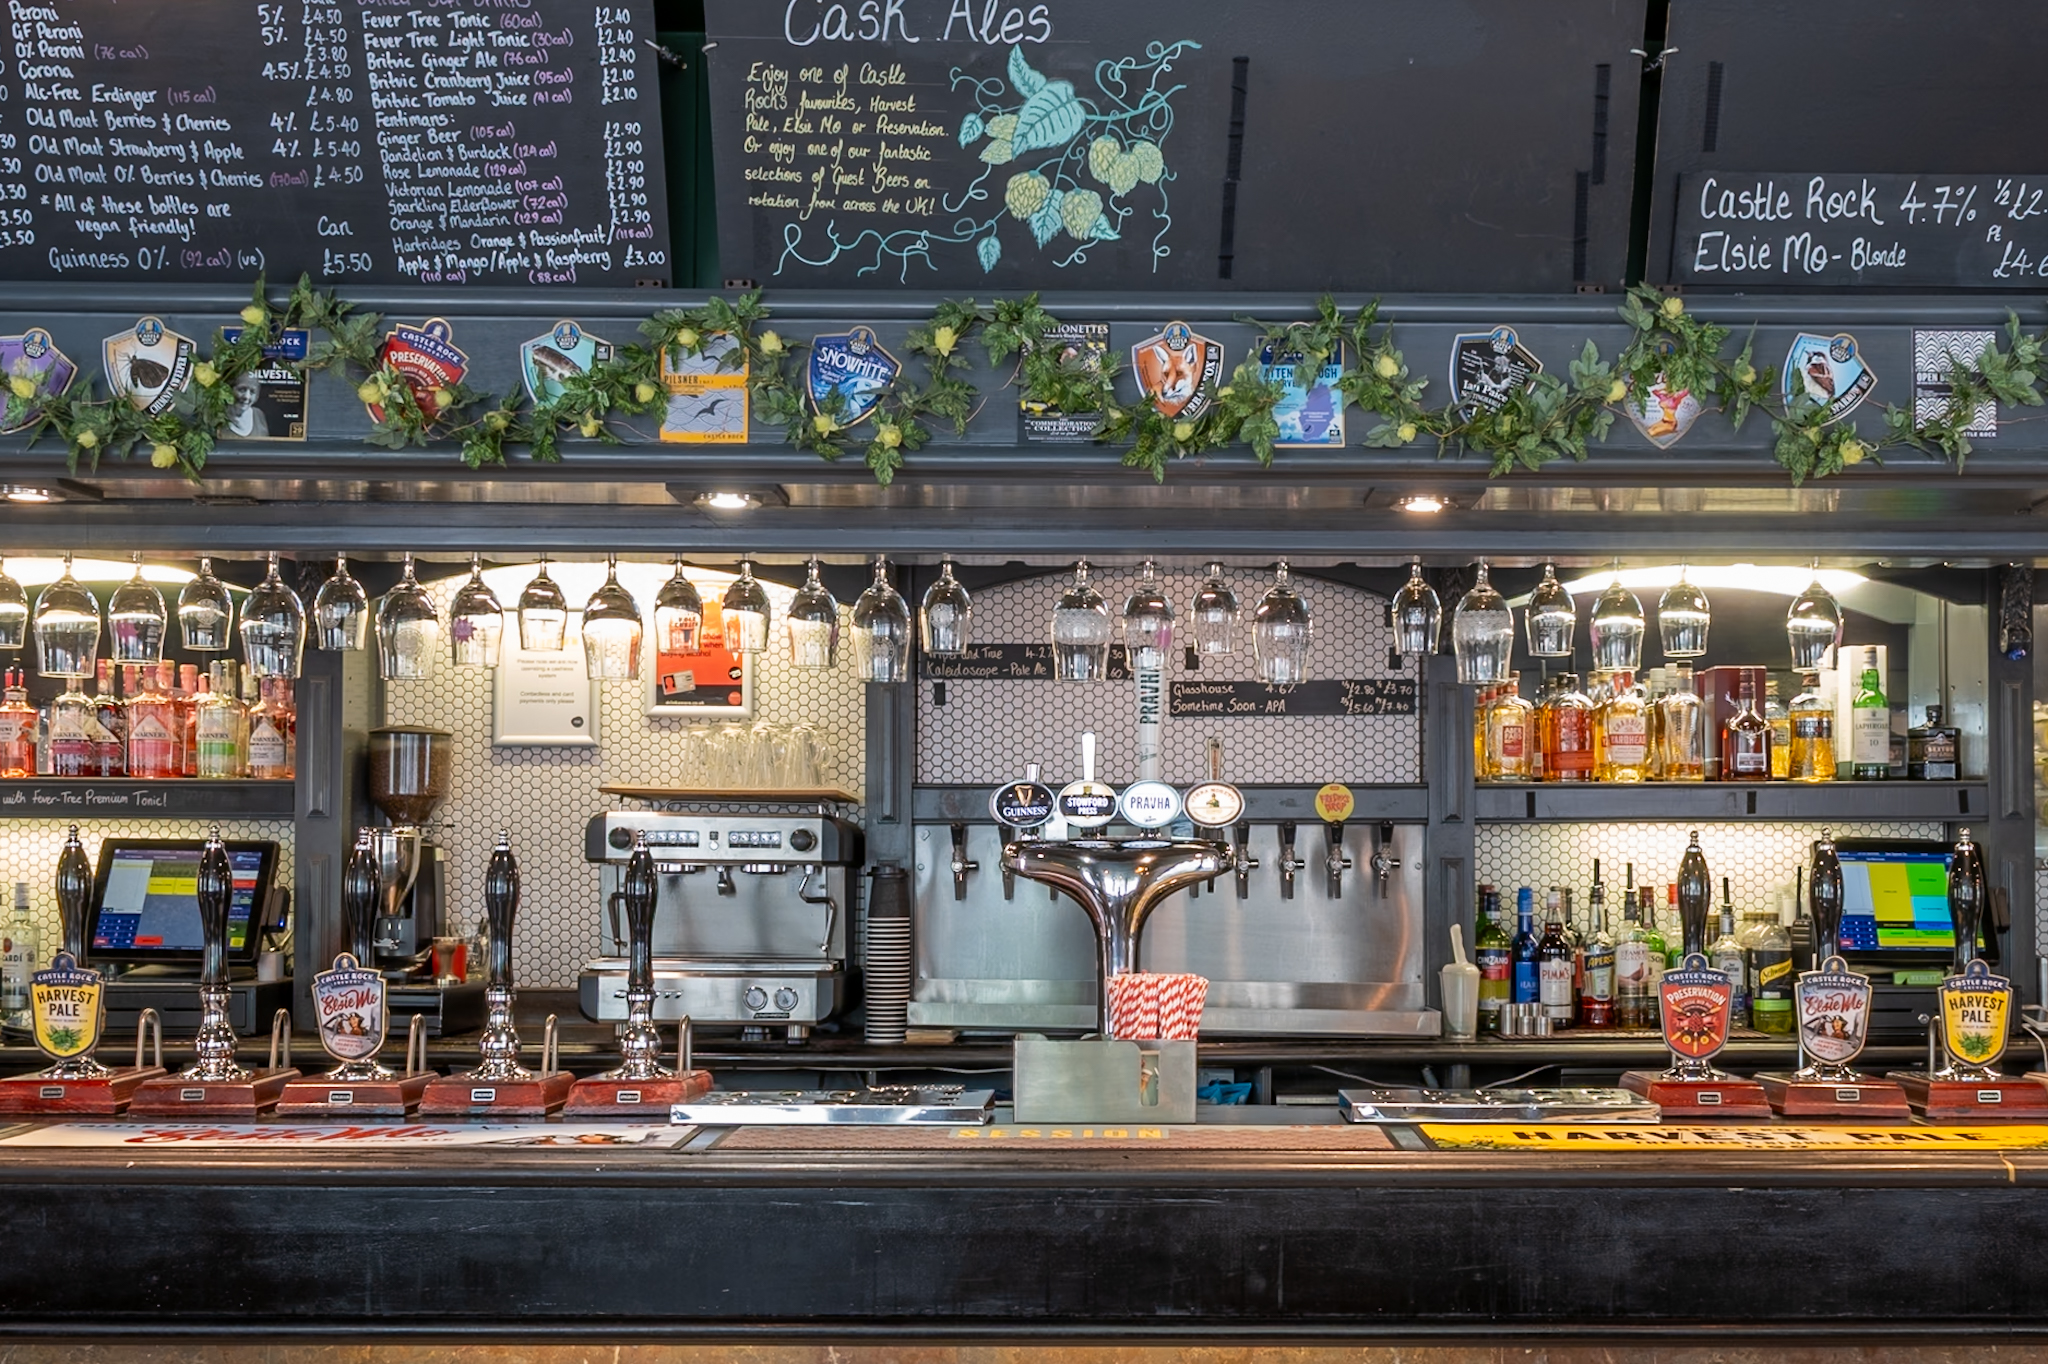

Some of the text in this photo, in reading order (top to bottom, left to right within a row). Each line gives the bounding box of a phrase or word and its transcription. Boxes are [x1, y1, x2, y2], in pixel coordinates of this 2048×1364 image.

[8, 1, 59, 21] Peroni
[257, 4, 342, 25] 5% £4.50
[361, 10, 491, 29] Fever Tree Tonic
[594, 6, 631, 28] £2.40
[784, 0, 1052, 46] Cask Ales
[15, 41, 85, 59] 0% Peroni
[18, 60, 74, 80] Corona
[366, 51, 498, 74] Britvic Ginger Ale
[368, 70, 530, 94] Britvic Cranberry Juice
[747, 61, 906, 98] Enjoy one of Castle
[25, 83, 157, 111] Alc-Free Erdinger
[795, 90, 861, 119] favourites,
[870, 94, 916, 113] Harvest
[26, 108, 231, 132] Old Mout Berries Cherries
[783, 117, 814, 134] Elsie
[820, 115, 841, 134] Mo
[852, 123, 866, 133] or
[876, 115, 949, 136] Preservation.
[29, 135, 244, 164] Old Mout Strawberry Apple
[376, 128, 462, 152] Ginger Beer
[380, 142, 513, 164] Dandelion Burdock
[744, 136, 931, 172] Or enjoy one of our fantastic
[382, 160, 481, 180] Rose Lemonade
[745, 166, 931, 195] selections of Guest Beers on
[80, 196, 96, 215] of
[101, 195, 144, 214] these
[148, 195, 199, 216] bottles
[206, 202, 232, 218] are
[388, 197, 520, 218] Sparkling Elderflower
[749, 191, 935, 221] rotation from across the UK!
[1700, 176, 1977, 226] Castle Rock 4.7%
[75, 217, 196, 242] vegan friendly!
[49, 246, 170, 272] Guinness 0%
[624, 244, 666, 268] £3.00
[1694, 231, 1772, 273] Elsie
[1850, 238, 1907, 272] Blonde
[436, 344, 460, 363] ROCK
[817, 346, 889, 383] SNOWHITE
[664, 375, 699, 385] PILSNER
[926, 662, 999, 678] Kaleidoscope
[1010, 661, 1031, 676] Pale
[1173, 683, 1235, 696] Glasshouse
[1171, 700, 1286, 714] Sometime Soon APA
[32, 788, 82, 805] Fever-Tree
[85, 788, 128, 805] Premium
[133, 790, 168, 807] Tonic!
[1067, 795, 1108, 808] STOWFORD
[1130, 796, 1171, 809] PRAVHA
[1003, 805, 1048, 818] GUINNESS
[1078, 806, 1098, 816] PRESS
[1477, 956, 1509, 965] CINZANO
[37, 972, 93, 982] CASTLE ROCK
[320, 973, 375, 984] CASTLE ROCK
[1541, 967, 1570, 980] PIMM'S
[1668, 973, 1724, 982] CASTLE ROCK
[1807, 975, 1862, 985] CASTLE ROCK
[1950, 979, 2003, 989] CASTLE ROCK
[37, 989, 95, 1004] HARVEST
[321, 988, 379, 1017] Elsie Mo
[1666, 987, 1726, 1005] PRESERVATION
[1803, 992, 1865, 1016] Elsie Mo
[1949, 996, 2004, 1010] HARVEST
[49, 1004, 80, 1017] PALE
[1961, 1010, 1991, 1023] PALE
[957, 1129, 1163, 1138] SESSION
[1512, 1130, 1803, 1141] HARVEST
[1839, 1131, 2000, 1141] PALE
